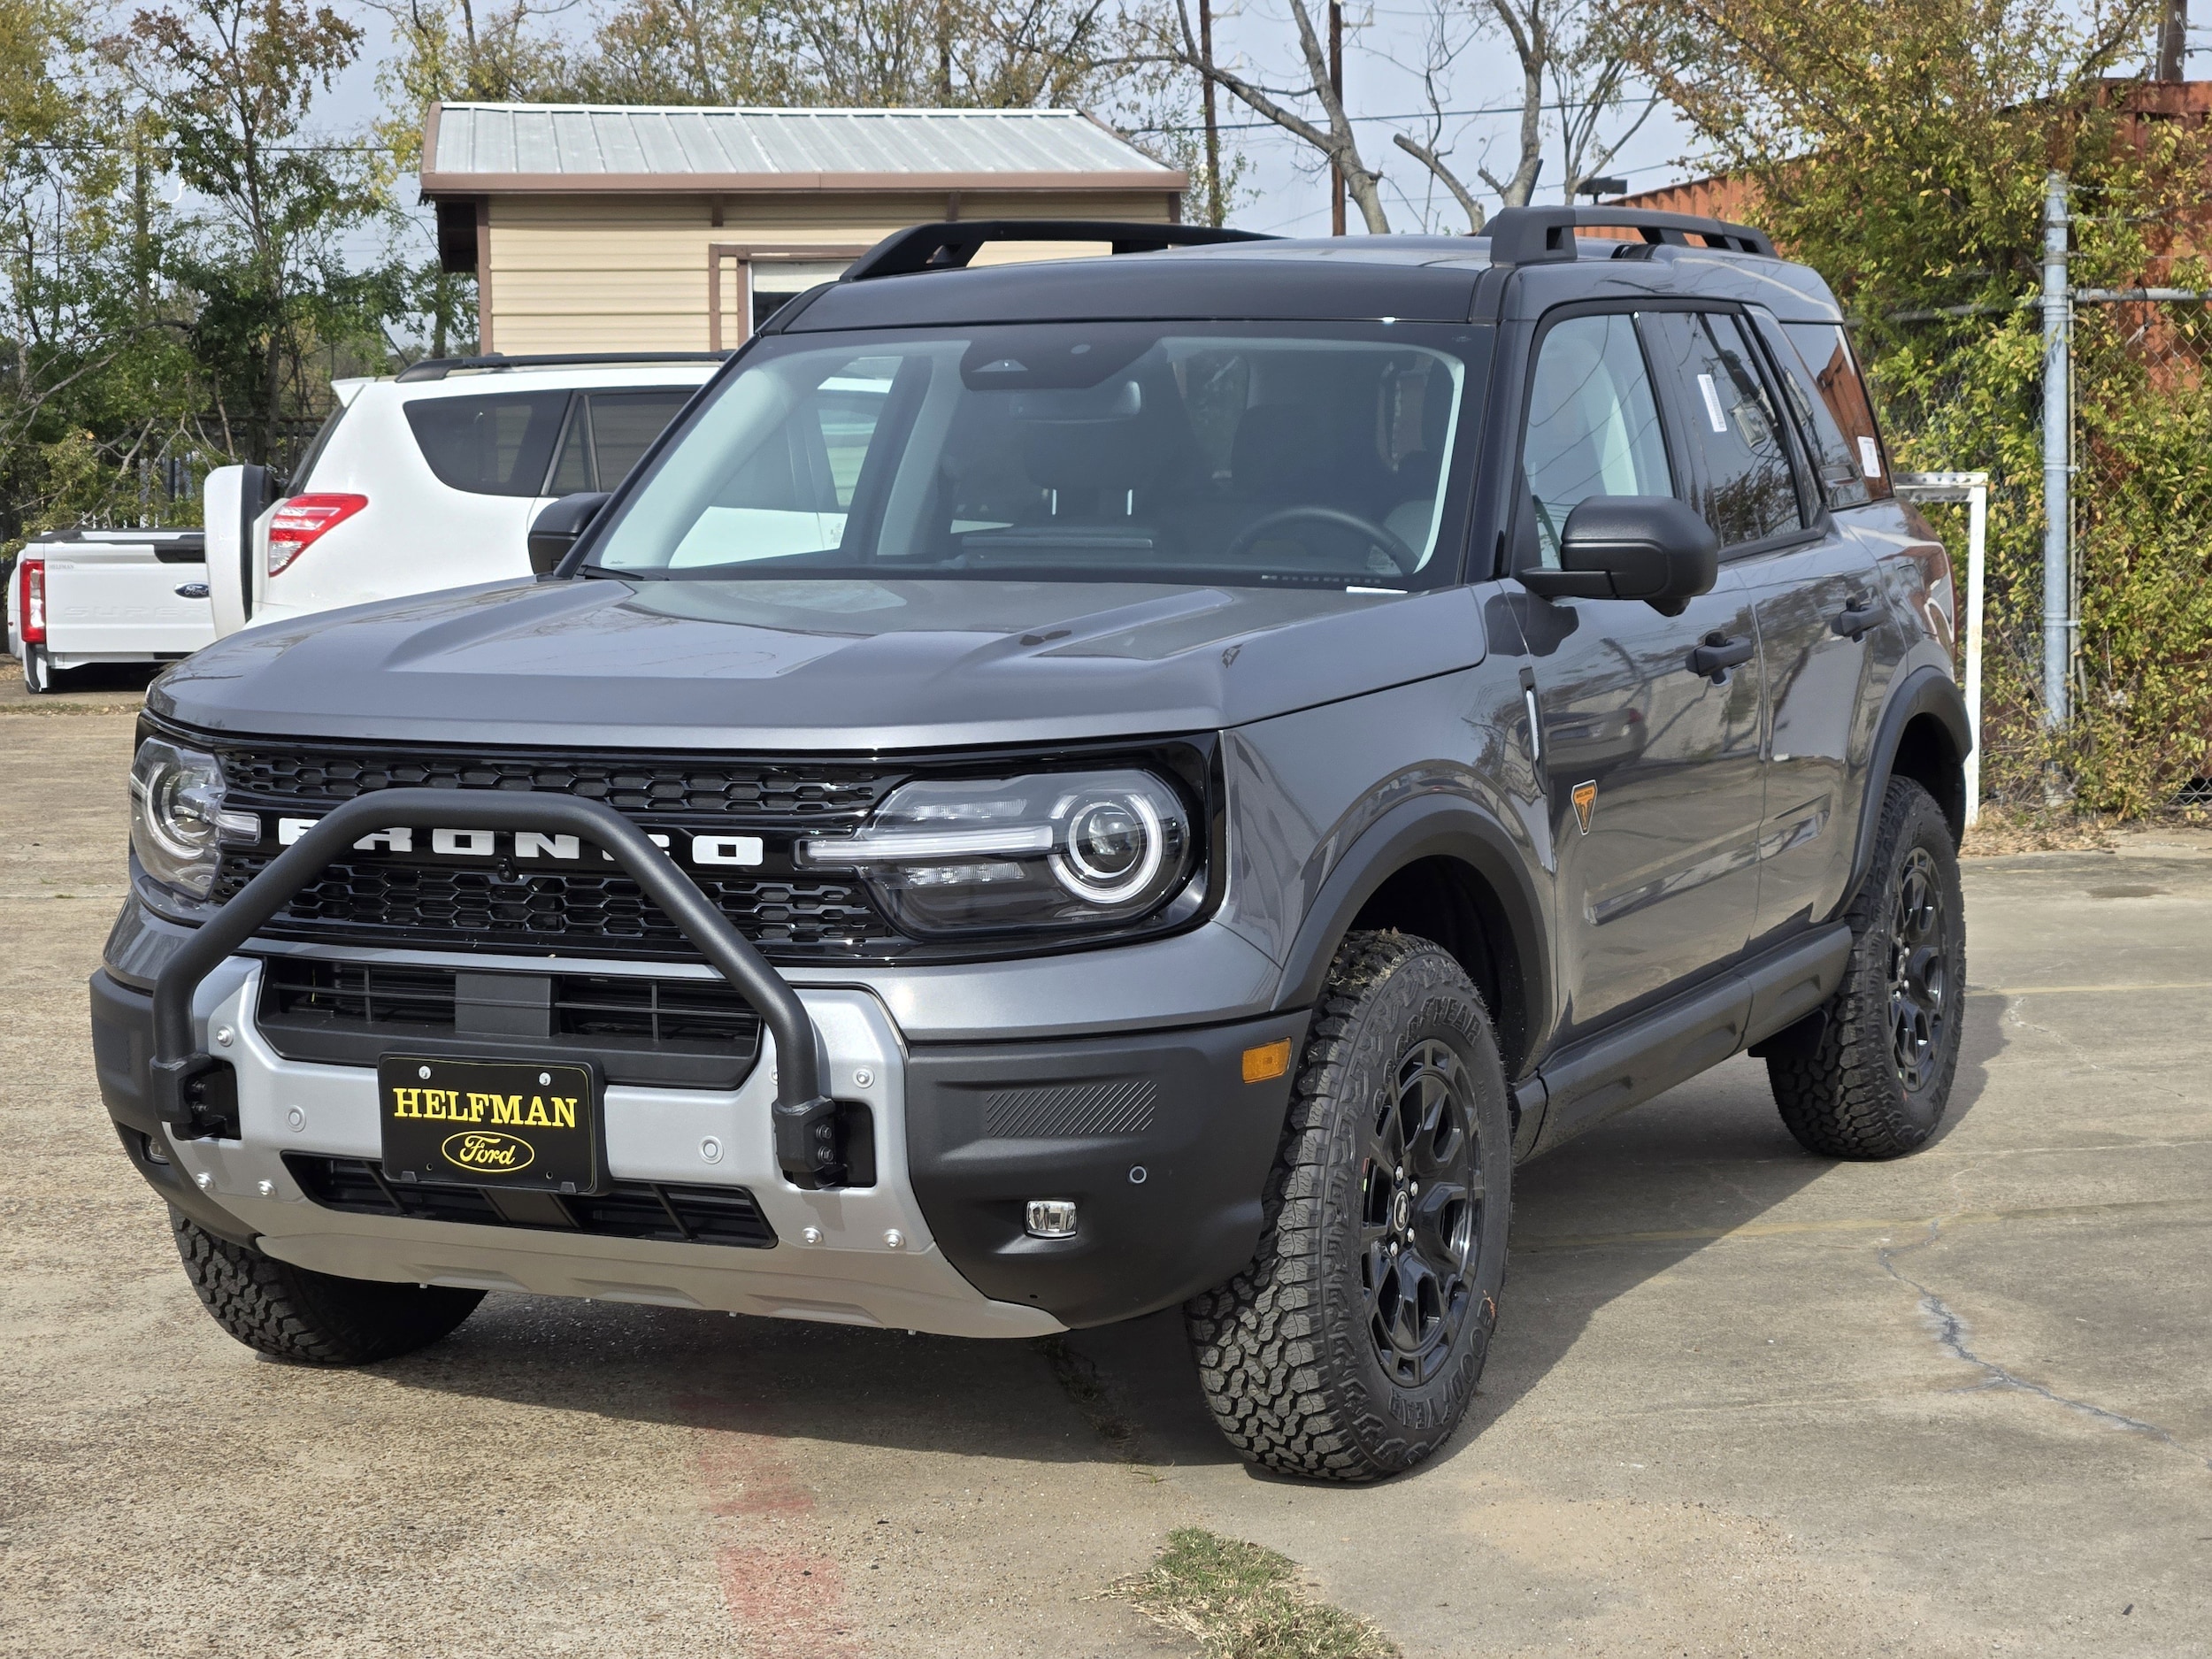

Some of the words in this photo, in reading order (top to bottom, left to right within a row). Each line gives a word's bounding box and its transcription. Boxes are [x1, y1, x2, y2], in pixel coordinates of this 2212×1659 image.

[183, 585, 209, 595] Ford
[64, 606, 209, 618] SUPER
[278, 818, 764, 866] RONO
[392, 1087, 578, 1128] HELFMAN
[459, 1134, 517, 1165] Ford
